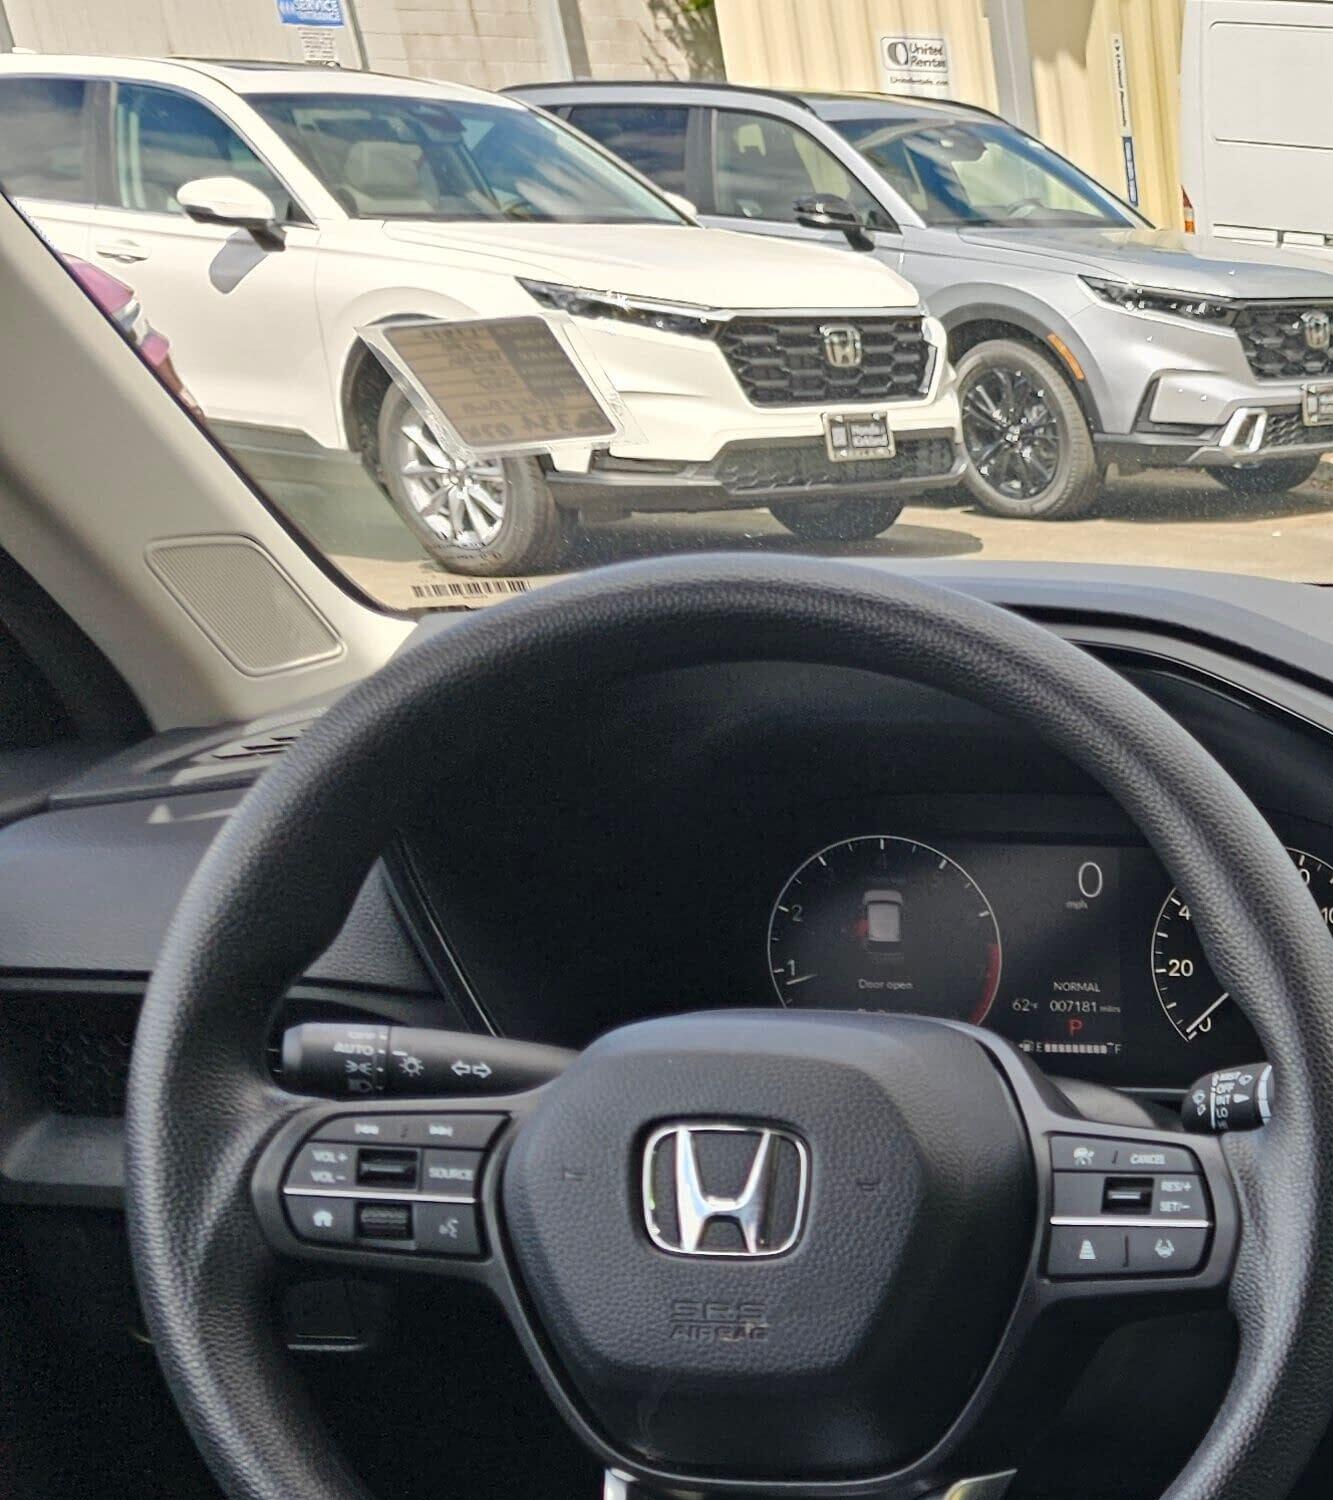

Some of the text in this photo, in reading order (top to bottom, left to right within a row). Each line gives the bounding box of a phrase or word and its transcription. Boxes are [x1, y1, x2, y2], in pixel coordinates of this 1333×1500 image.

[909, 42, 944, 56] United
[1078, 862, 1103, 898] 0
[791, 903, 803, 922] 2
[787, 959, 796, 976] 1
[1168, 959, 1194, 977] 20
[857, 978, 914, 991] Door open
[1053, 981, 1101, 993] NORMAL
[1049, 1000, 1097, 1013] 007181
[1068, 1019, 1083, 1036] P
[333, 1041, 374, 1057] AUTO
